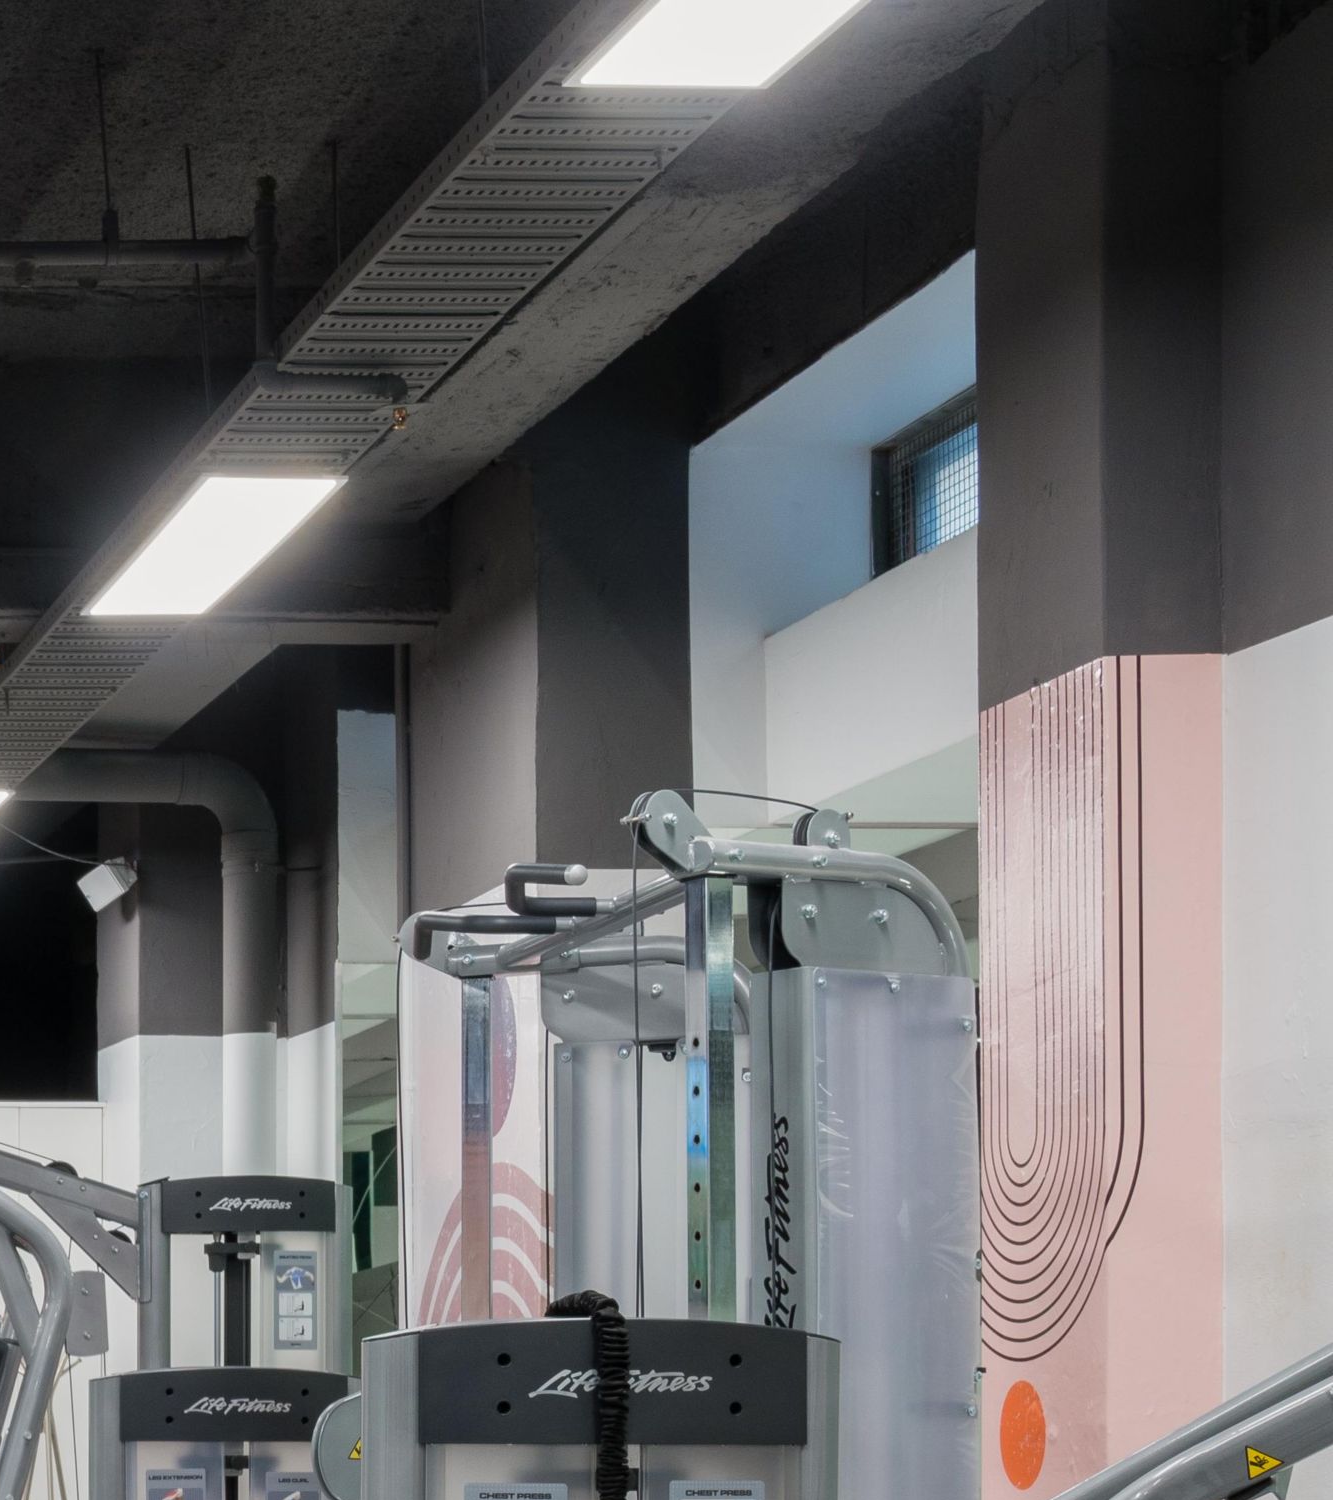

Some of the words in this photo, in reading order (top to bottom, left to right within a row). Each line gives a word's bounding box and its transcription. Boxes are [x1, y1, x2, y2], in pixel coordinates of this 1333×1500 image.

[764, 1112, 798, 1275] Fitness
[209, 1197, 242, 1211] Life
[240, 1197, 293, 1212] Fitness
[528, 1368, 601, 1399] Life
[627, 1369, 714, 1394] itness
[183, 1396, 228, 1415] Life
[223, 1397, 292, 1416] Fitness
[478, 1492, 516, 1500] CHEST
[516, 1492, 553, 1500] PRESS
[685, 1489, 719, 1497] CHEST
[719, 1489, 753, 1497] PRESS
